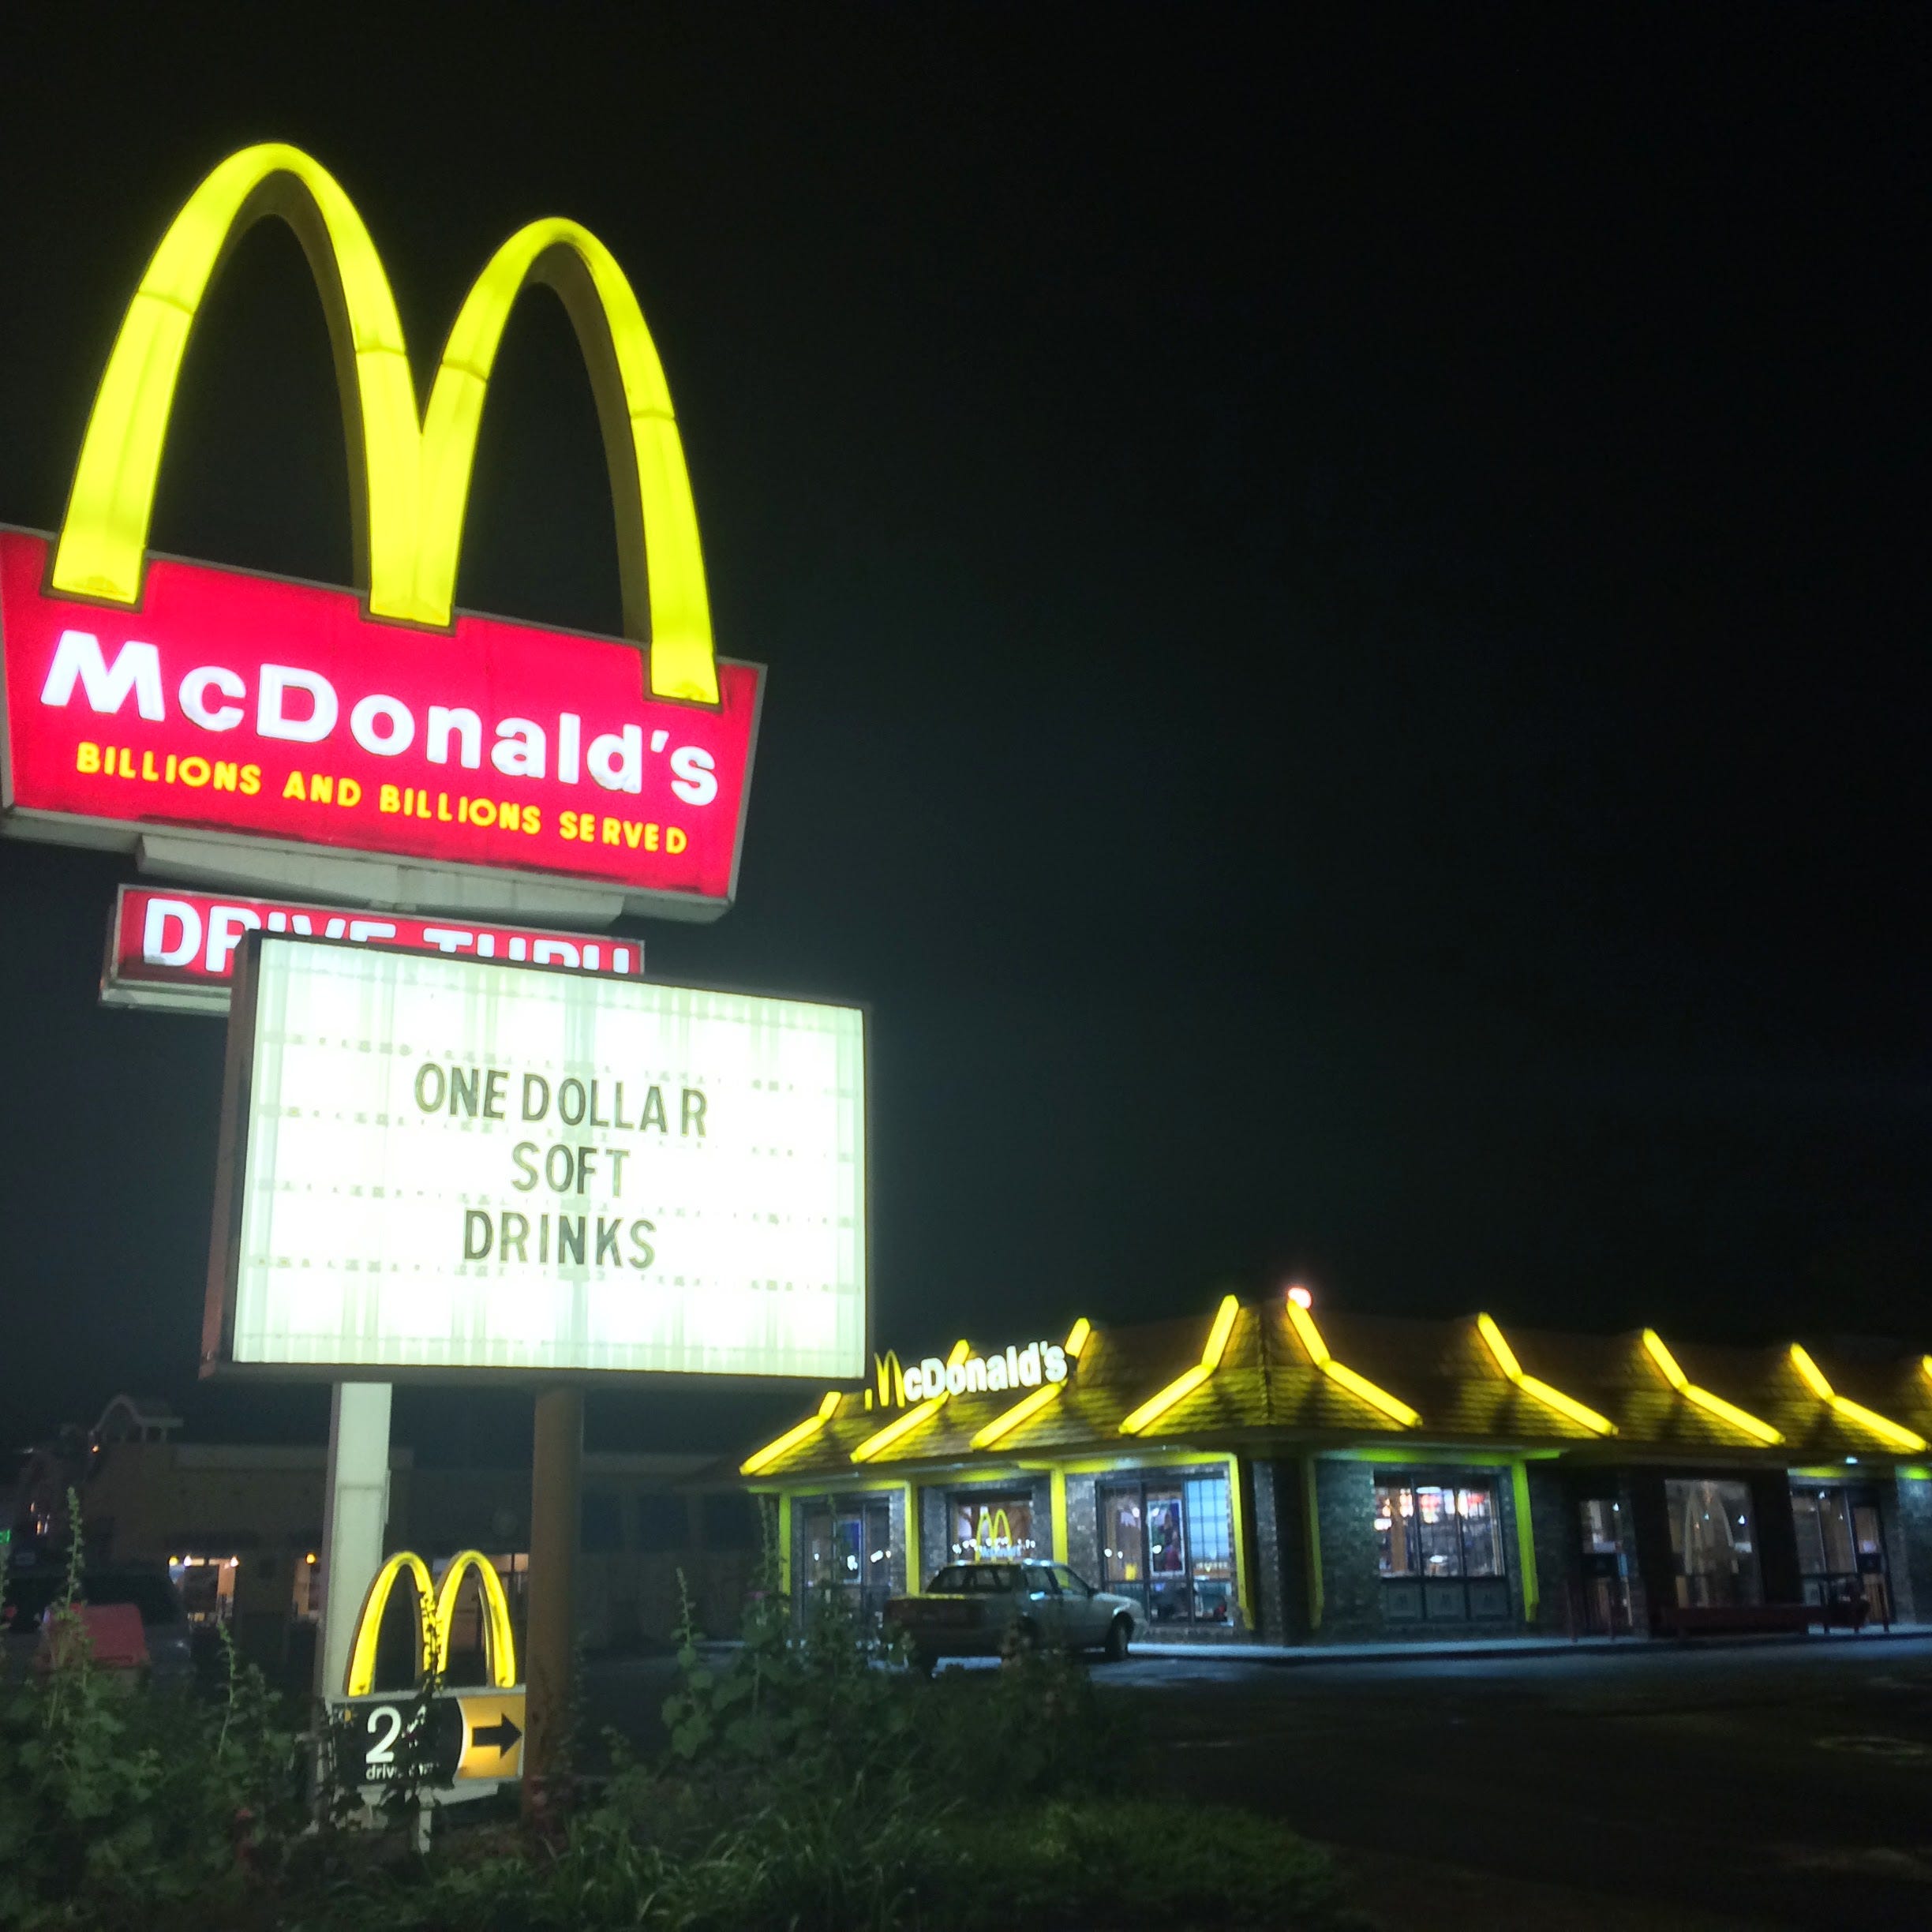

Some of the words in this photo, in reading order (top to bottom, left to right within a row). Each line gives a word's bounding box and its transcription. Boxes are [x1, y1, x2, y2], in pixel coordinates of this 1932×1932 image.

[40, 630, 718, 806] McDonald's
[77, 741, 261, 796] BILLIONS
[283, 770, 361, 807] AND
[379, 784, 541, 835] BILLIONS
[559, 811, 687, 855] SERVED
[511, 1140, 631, 1197] SOFT
[463, 1208, 657, 1270] DRINKS
[865, 1340, 1067, 1410] McDonald's
[365, 1763, 403, 1780] driv
